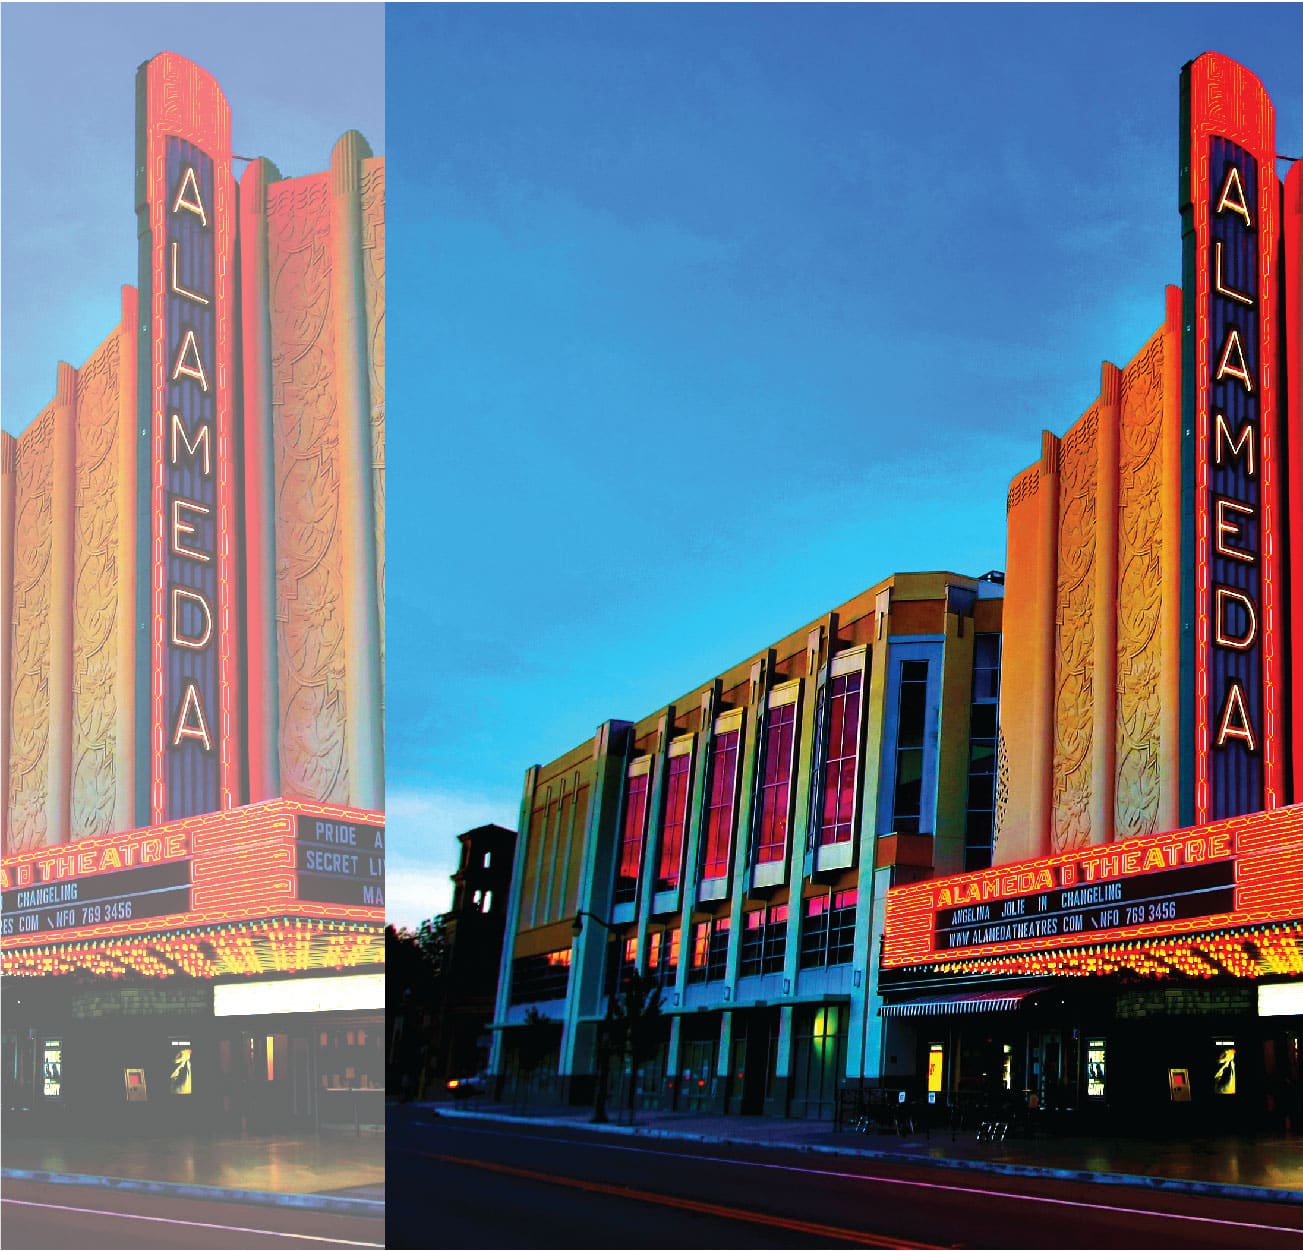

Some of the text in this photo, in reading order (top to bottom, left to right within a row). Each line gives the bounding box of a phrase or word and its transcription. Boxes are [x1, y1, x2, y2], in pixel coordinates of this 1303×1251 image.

[170, 166, 212, 751] ALAMEDA
[1214, 166, 1256, 751] ALAMEDA
[315, 821, 356, 846] PRIDE
[38, 833, 187, 881] THEATRE
[306, 850, 358, 874] SECRET
[936, 833, 1231, 907] ALAMEDA THEATRE
[17, 883, 78, 909] CHANGELING
[19, 915, 39, 932] COM
[82, 905, 101, 925] 769
[104, 901, 132, 921] 3456
[951, 883, 1122, 925] ANGELINA JOLIE IN CHANGELING
[949, 932, 970, 948] WWW
[972, 918, 1058, 945] ALAMEDATHEATRES
[1063, 915, 1083, 932] COM
[1126, 905, 1145, 925] 769
[1148, 901, 1176, 921] 3456
